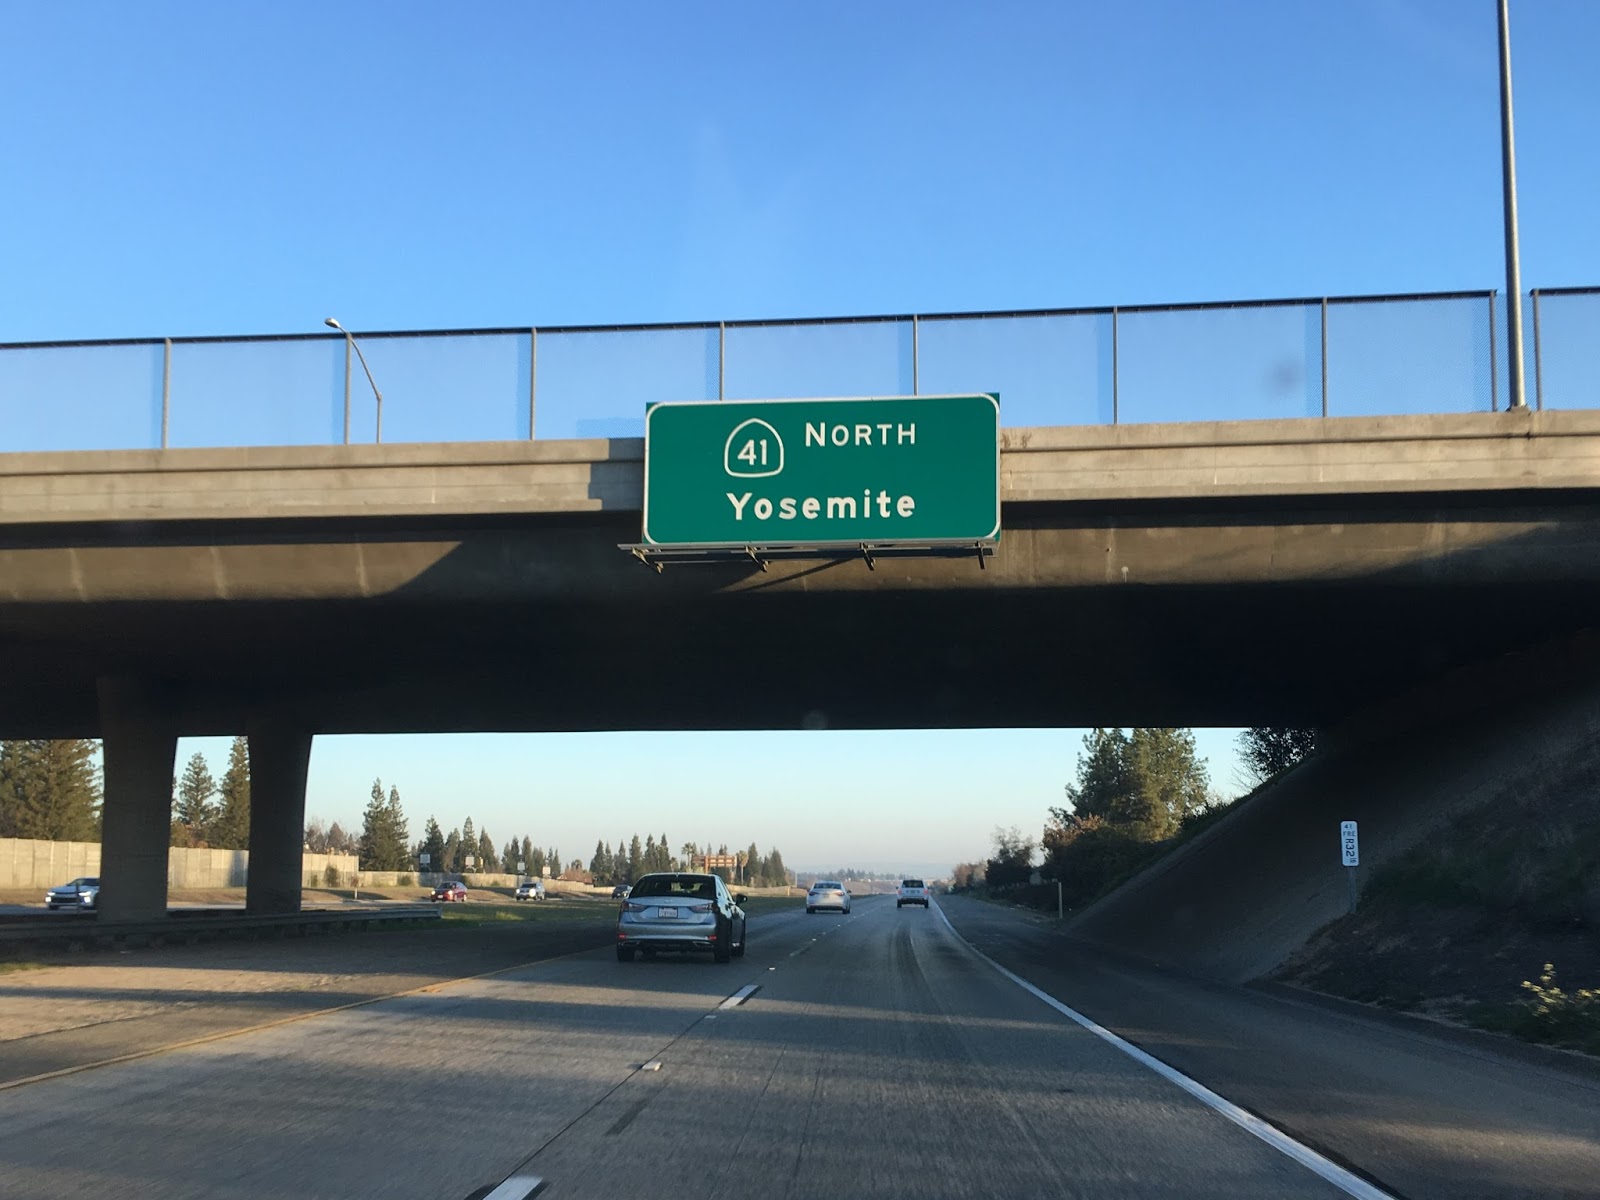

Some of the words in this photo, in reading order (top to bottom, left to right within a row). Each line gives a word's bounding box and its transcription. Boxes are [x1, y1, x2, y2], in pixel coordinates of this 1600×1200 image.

[737, 439, 768, 466] 41
[805, 422, 916, 447] NORTH
[726, 488, 916, 521] Yosemite
